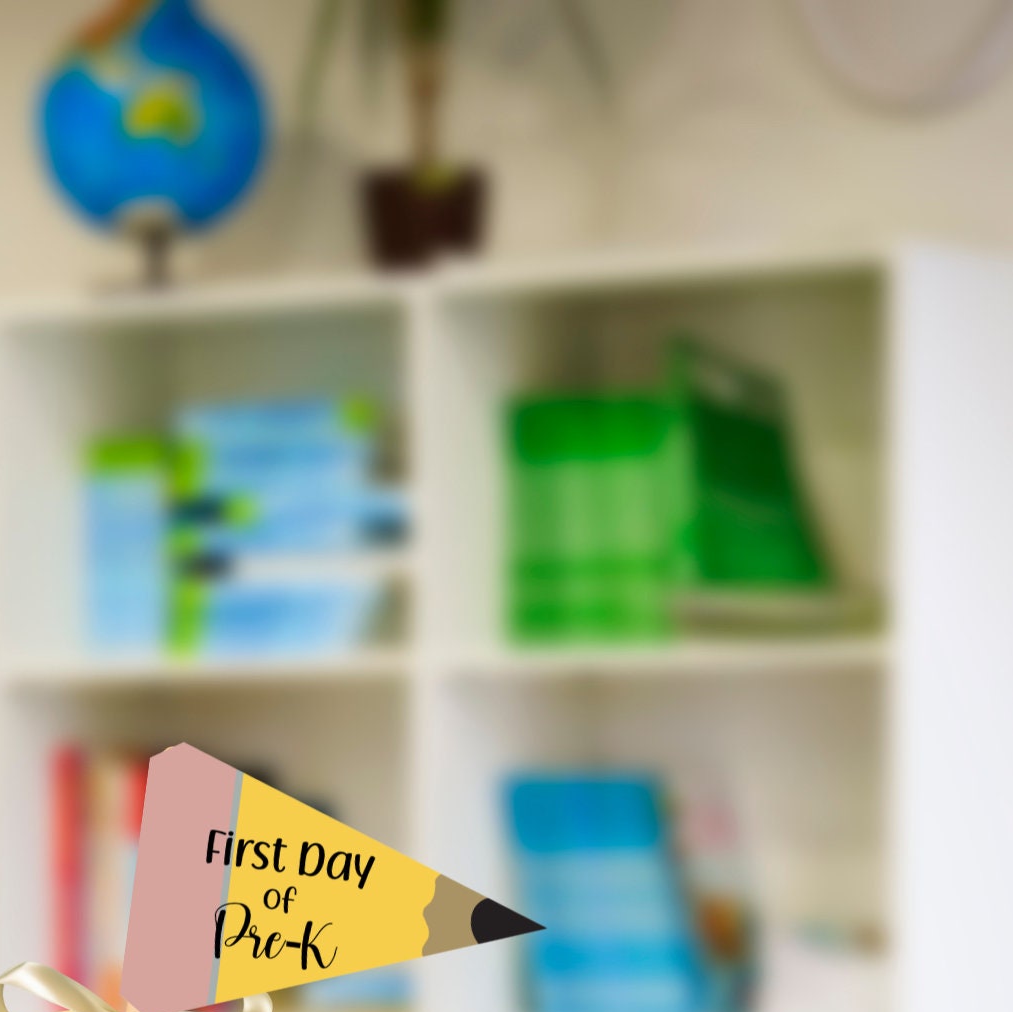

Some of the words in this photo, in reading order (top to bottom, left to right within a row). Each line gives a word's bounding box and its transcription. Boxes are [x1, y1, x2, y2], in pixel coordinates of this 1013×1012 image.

[205, 829, 288, 873] First
[298, 841, 376, 890] Day
[263, 886, 297, 914] of
[214, 902, 338, 970] Pre-K
